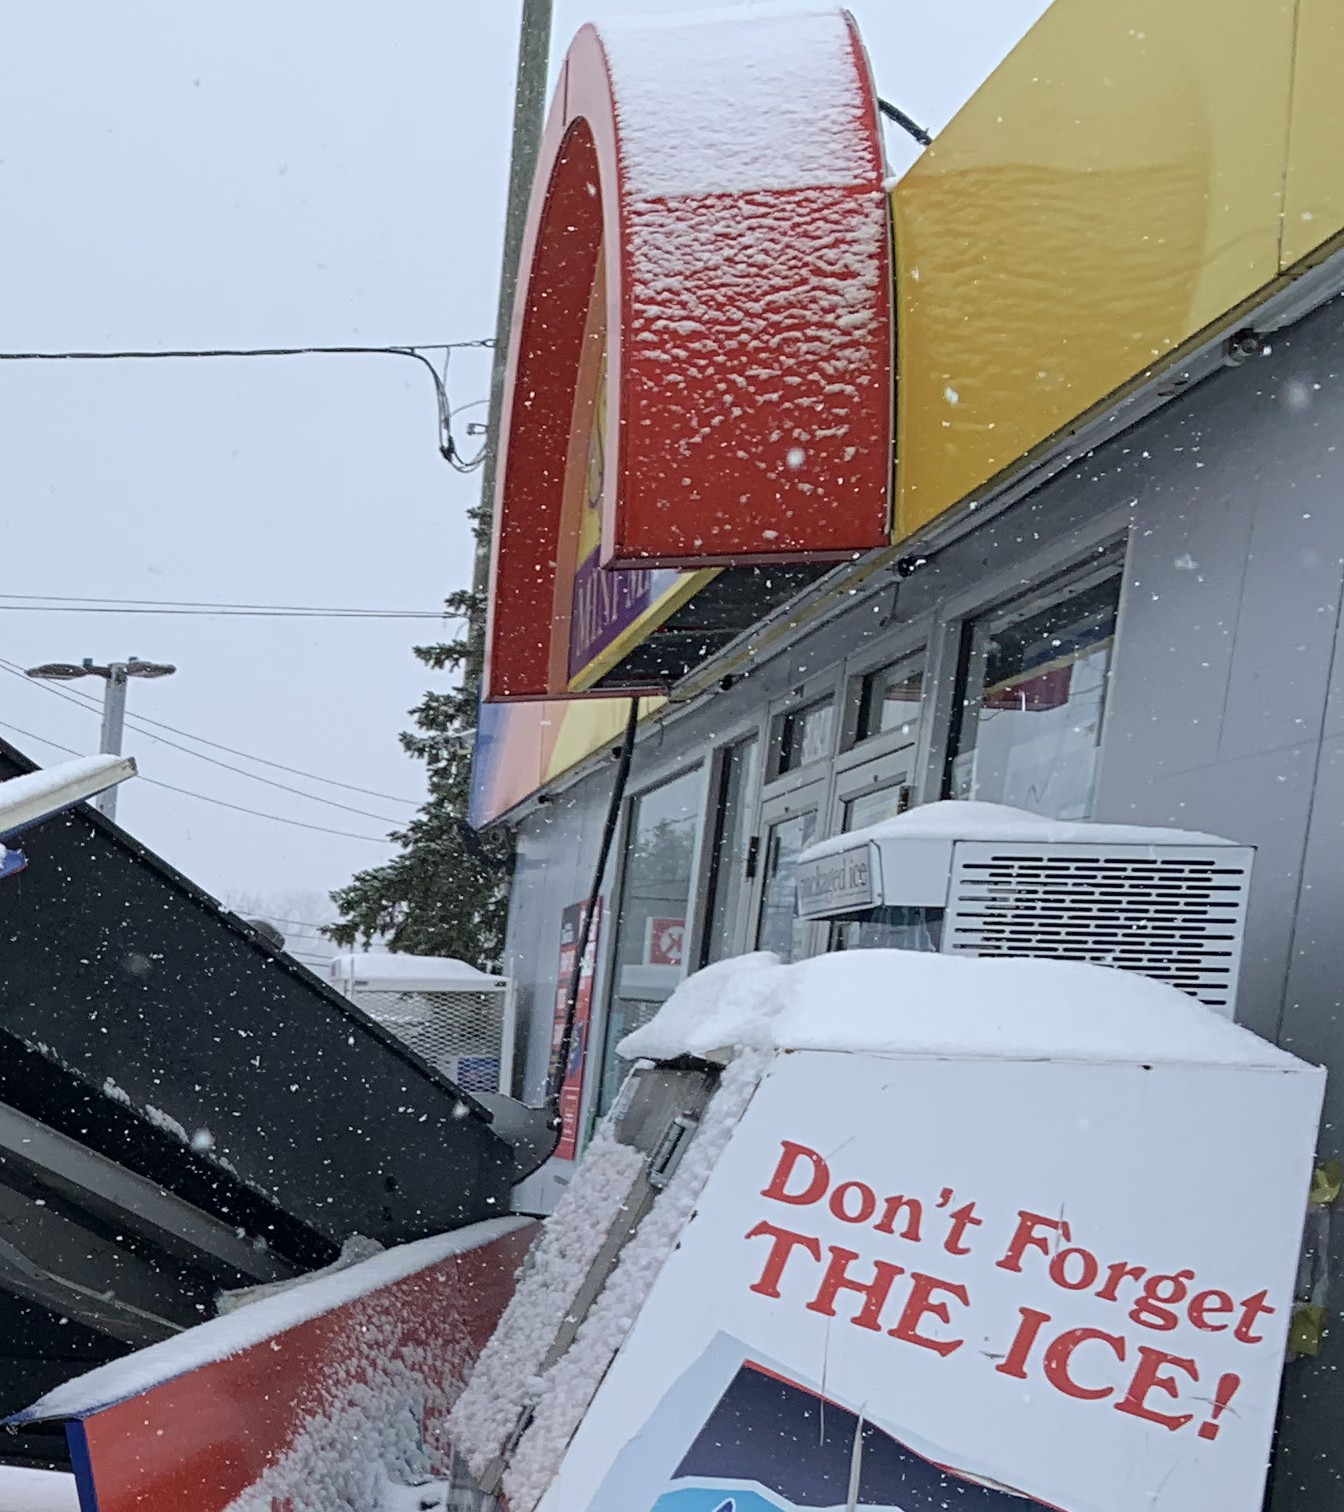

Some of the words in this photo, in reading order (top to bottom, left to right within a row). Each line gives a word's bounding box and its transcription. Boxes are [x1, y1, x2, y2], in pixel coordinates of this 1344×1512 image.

[745, 1220, 971, 1357] THE
[996, 1306, 1243, 1442] ICE!
[760, 1139, 984, 1255] Don't
[996, 1209, 1277, 1345] Forget
